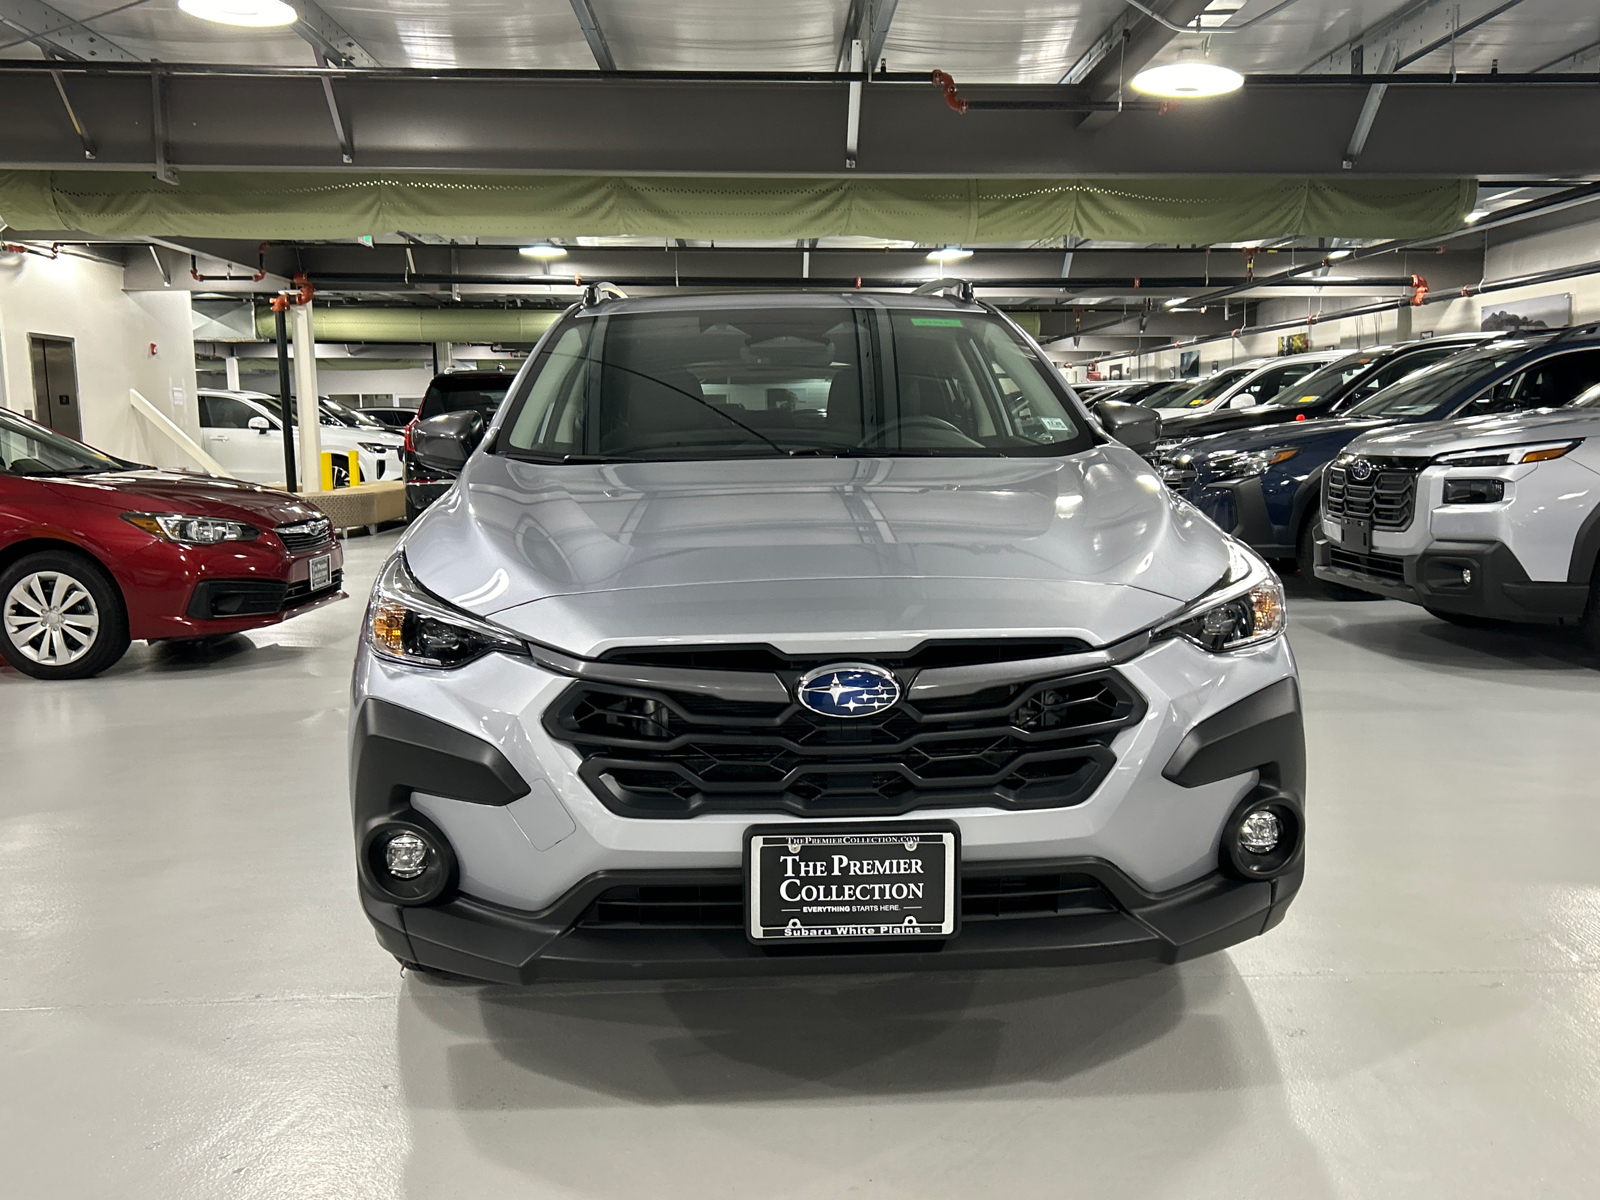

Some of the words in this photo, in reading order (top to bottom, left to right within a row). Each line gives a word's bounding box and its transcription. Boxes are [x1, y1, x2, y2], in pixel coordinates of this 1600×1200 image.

[780, 855, 827, 877] THE
[831, 854, 924, 876] PREMIER
[780, 878, 924, 902] COLLECTION
[784, 928, 832, 936] Subaru
[835, 927, 876, 935] White
[881, 926, 921, 934] Plains
